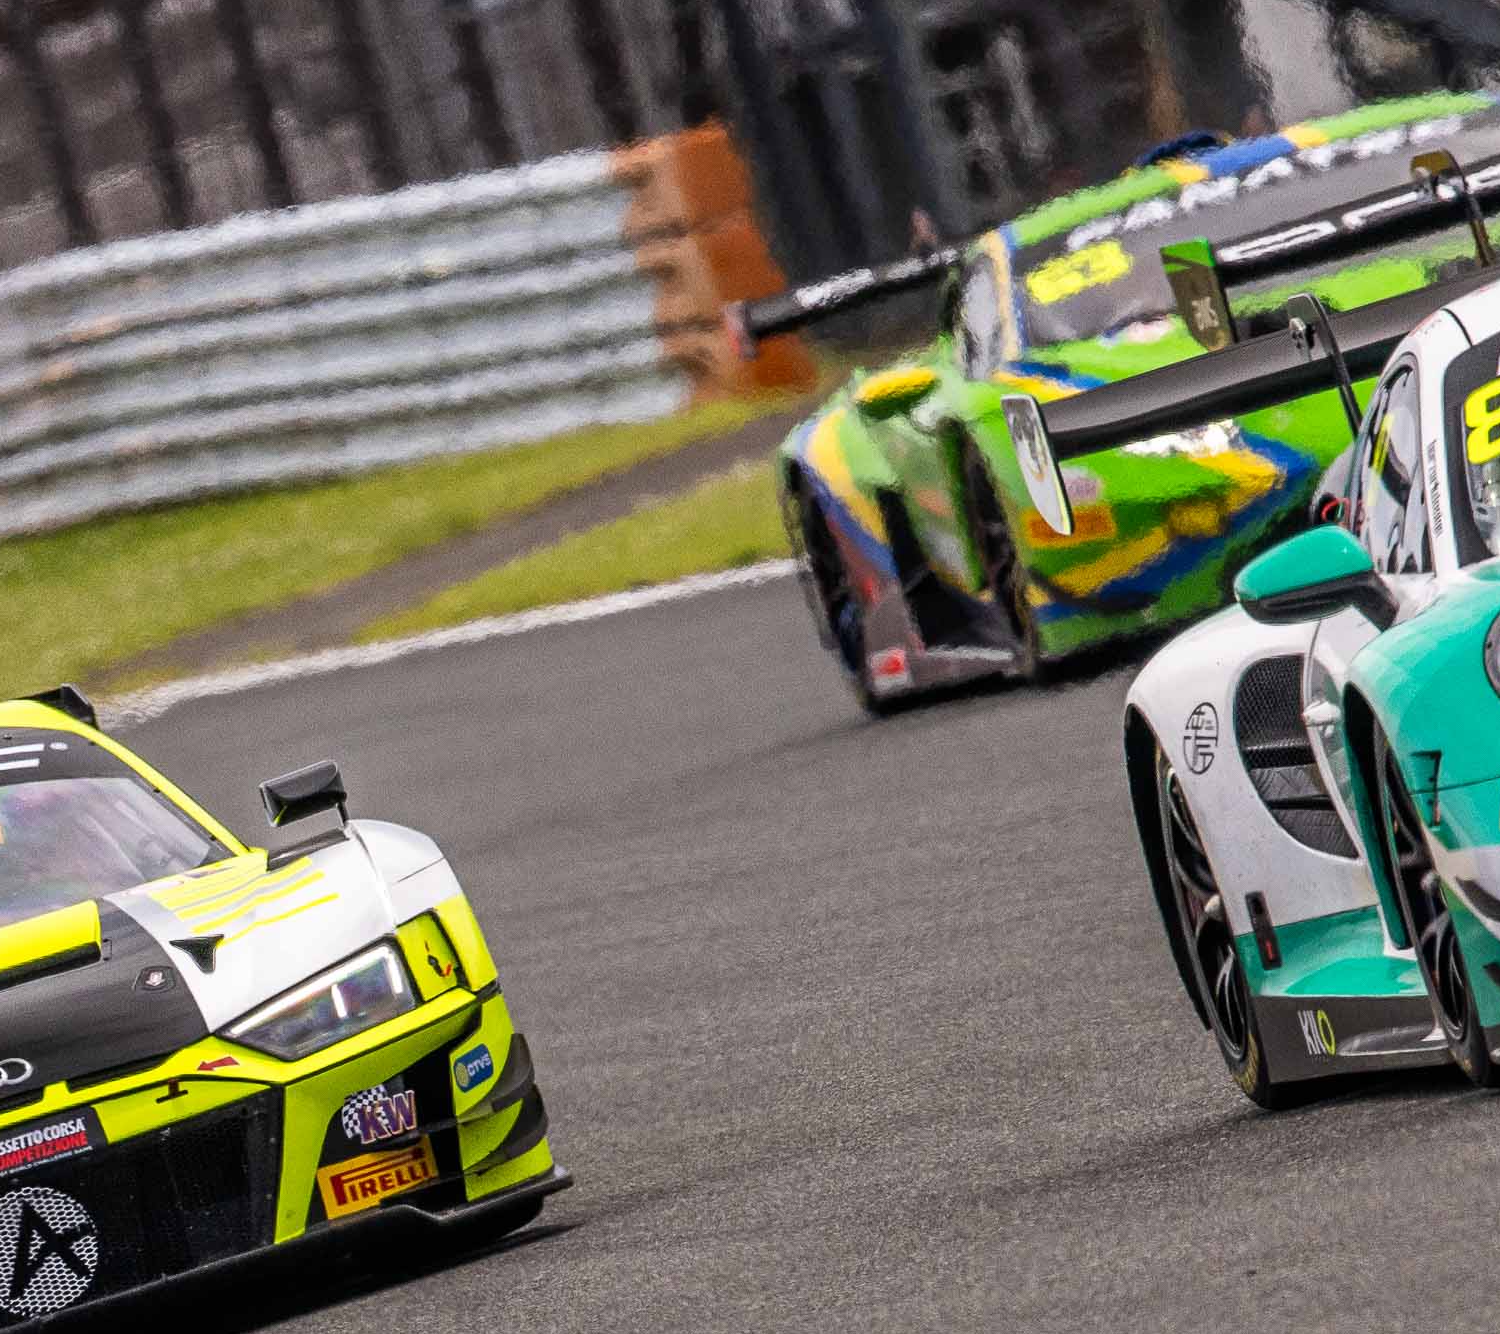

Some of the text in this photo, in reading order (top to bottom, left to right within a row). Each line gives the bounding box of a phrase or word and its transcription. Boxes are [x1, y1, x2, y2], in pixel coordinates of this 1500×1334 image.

[43, 1118, 86, 1141] CORSA
[359, 1090, 416, 1144] KW
[329, 1142, 434, 1207] PIRELLI
